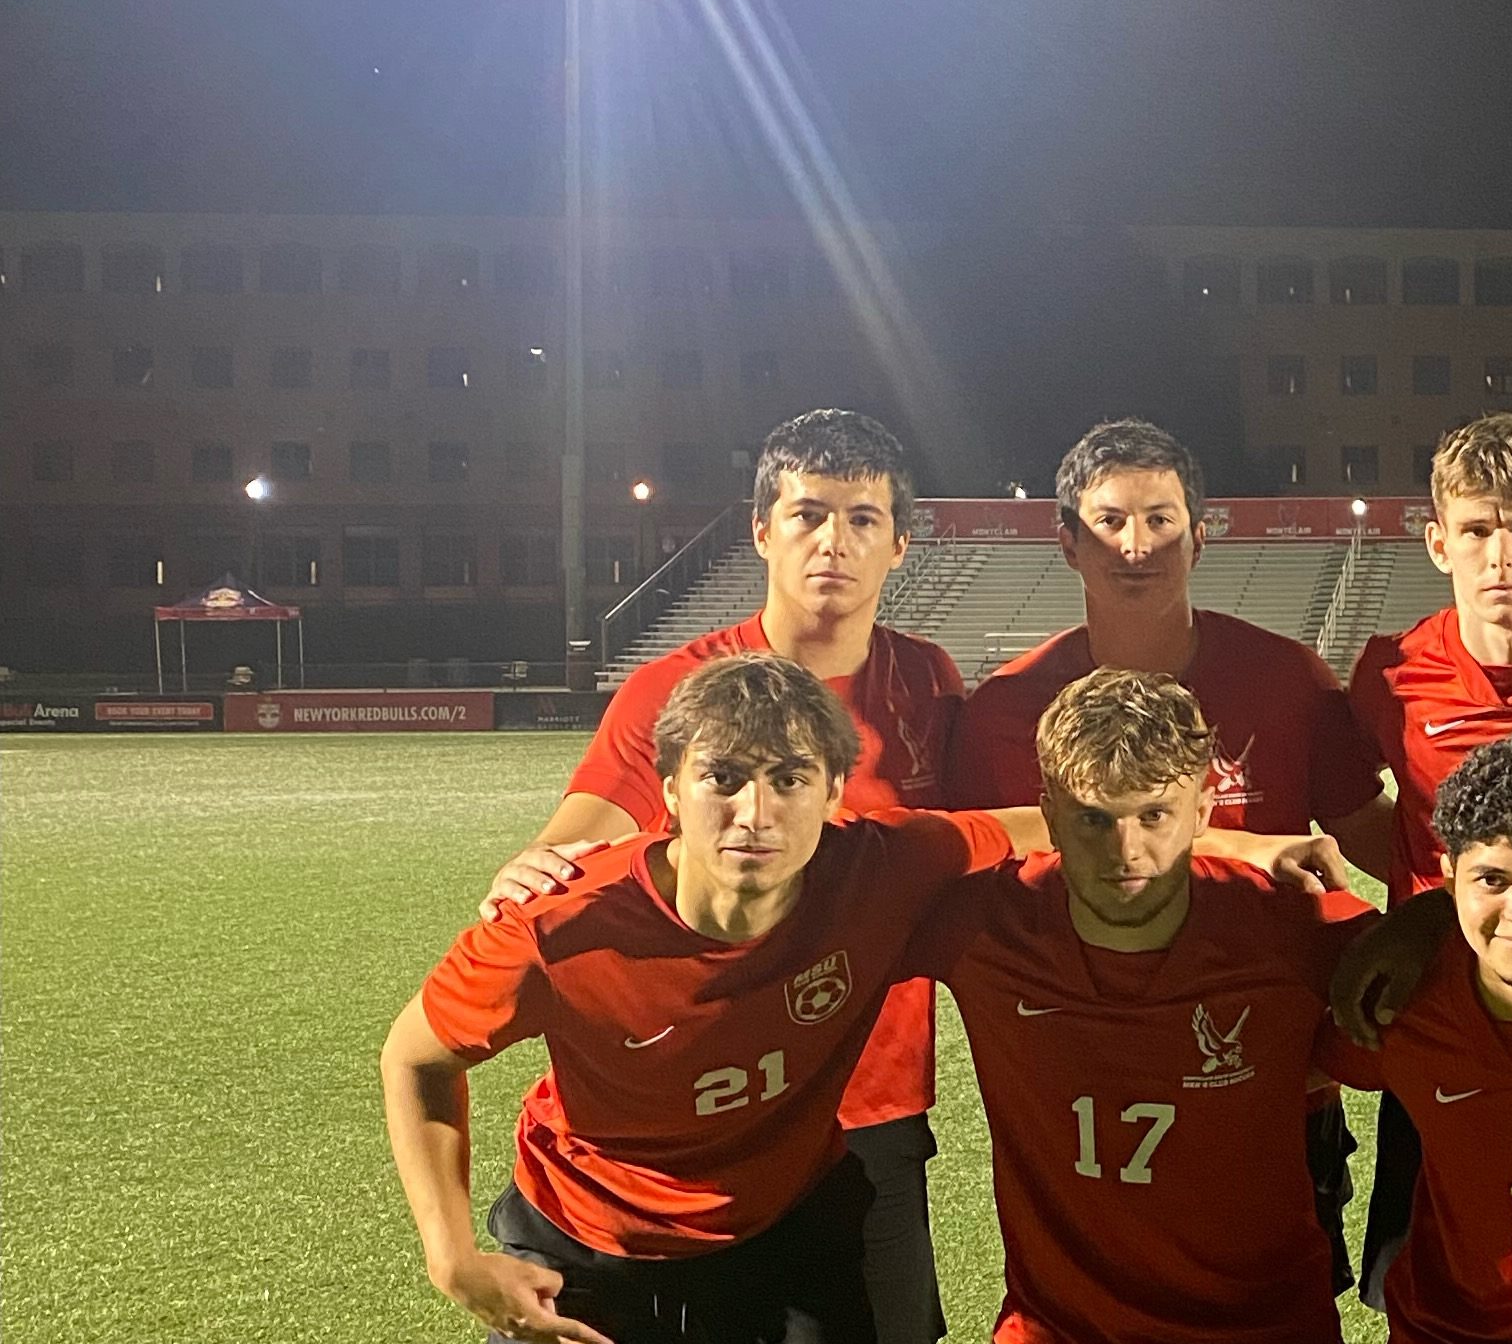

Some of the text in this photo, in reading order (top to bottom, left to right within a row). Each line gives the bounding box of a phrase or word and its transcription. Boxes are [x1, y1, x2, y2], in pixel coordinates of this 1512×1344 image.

[34, 703, 79, 718] Arena
[294, 706, 467, 722] NEWYORKREDBULLS.COM/2
[793, 956, 838, 989] MSU
[693, 1050, 790, 1116] 21
[1072, 1096, 1175, 1184] 17
